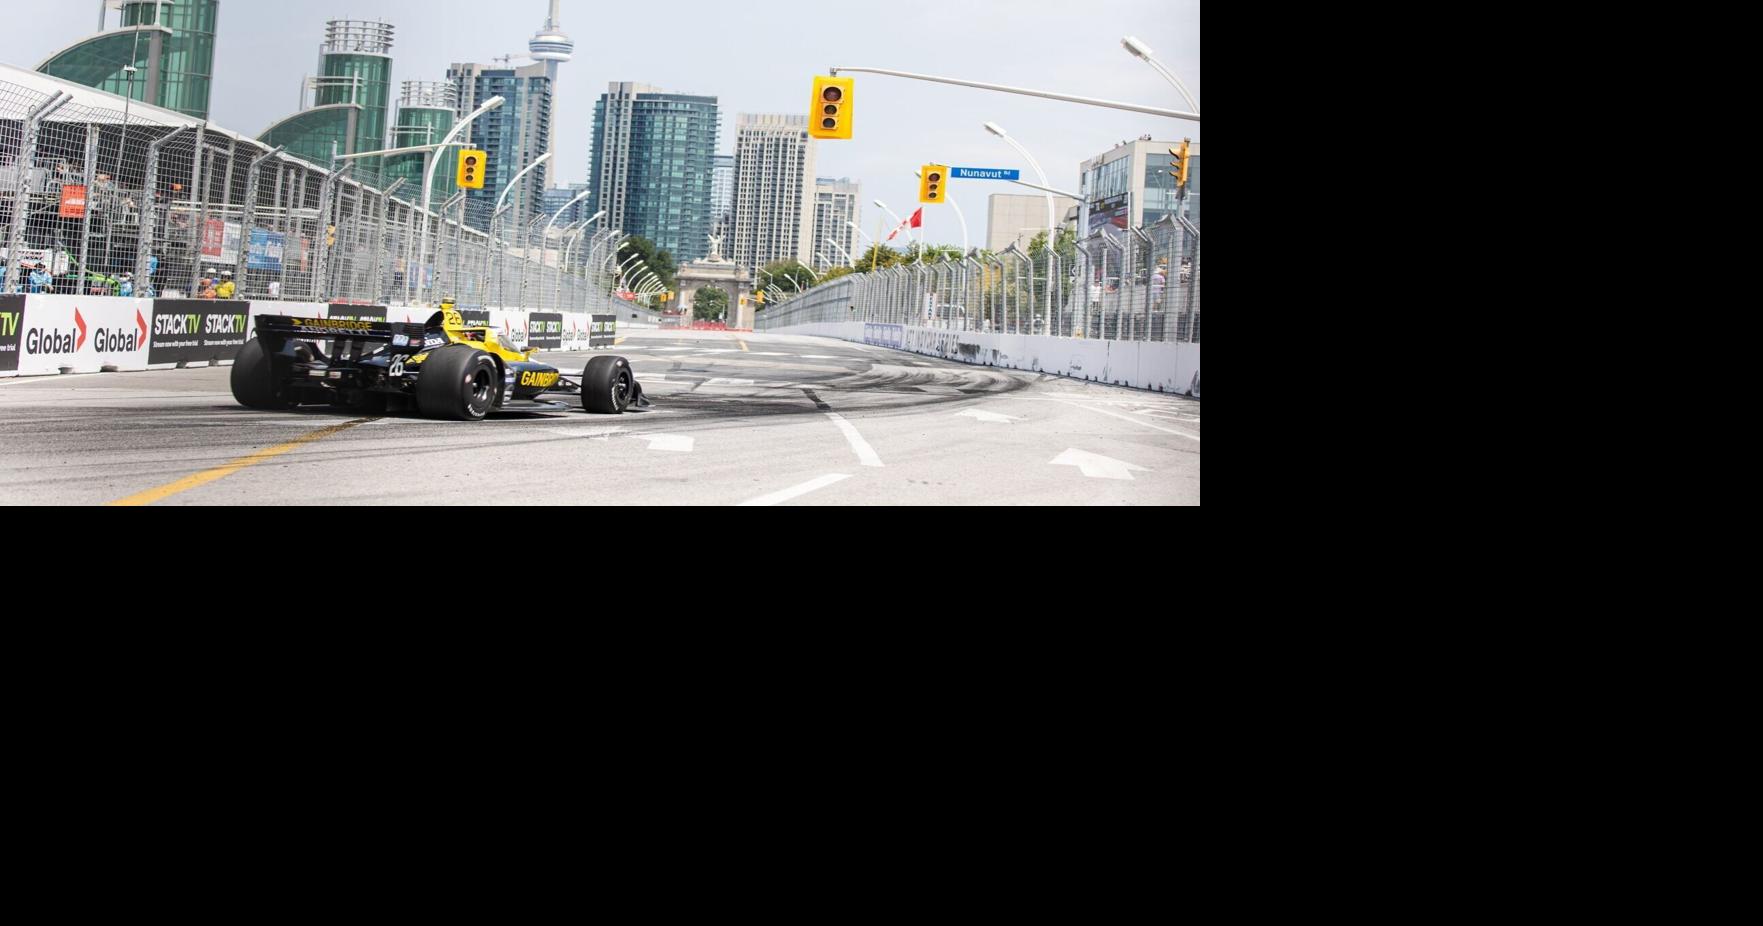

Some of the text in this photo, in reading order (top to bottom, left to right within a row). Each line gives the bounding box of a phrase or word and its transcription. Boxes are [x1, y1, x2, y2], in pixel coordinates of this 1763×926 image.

[960, 169, 1002, 178] Nunavut
[154, 313, 201, 335] STACKTV
[205, 313, 247, 334] STACKTV
[304, 318, 373, 330] GAINBRIDGE
[26, 327, 76, 355] Global
[94, 327, 137, 353] Global
[389, 354, 409, 376] 26
